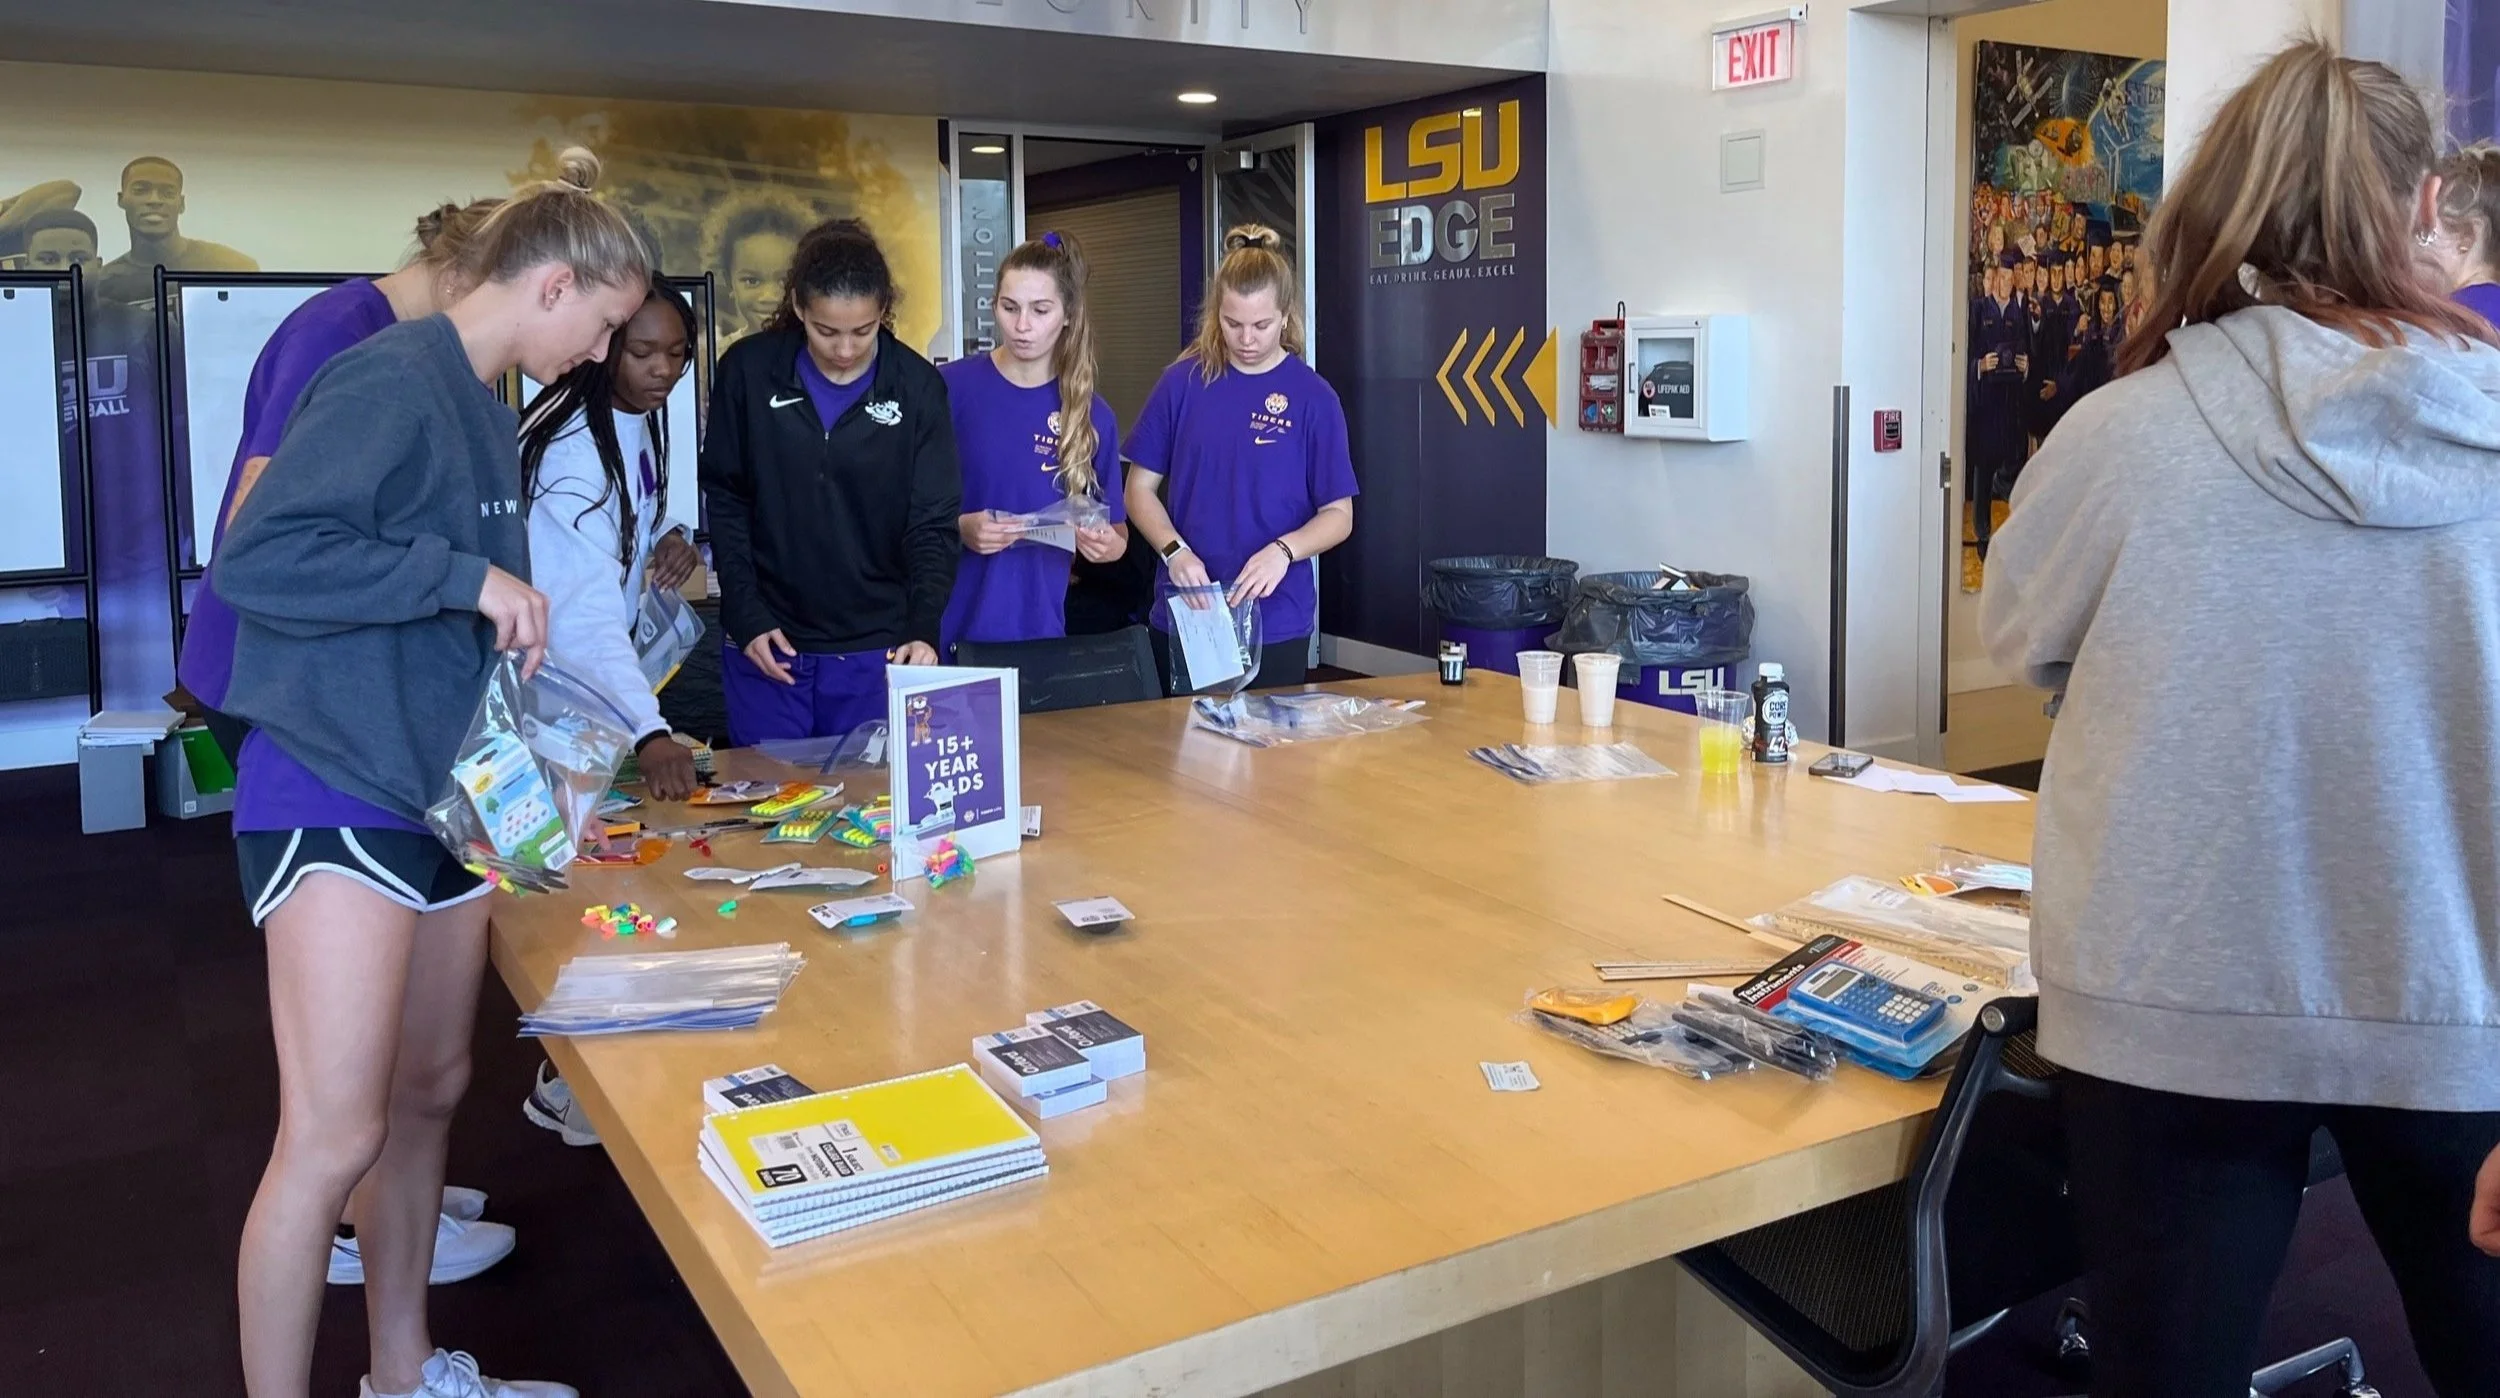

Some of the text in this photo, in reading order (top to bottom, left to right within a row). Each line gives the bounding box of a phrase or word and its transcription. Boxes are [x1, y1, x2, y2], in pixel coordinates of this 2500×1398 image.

[1728, 28, 1780, 83] EXIT
[1364, 99, 1520, 204] LSU
[1369, 193, 1516, 269] EDGE
[480, 499, 518, 518] NEW
[1658, 667, 1725, 697] LSU
[936, 735, 974, 757] 15+
[925, 752, 979, 780] YEAR
[1738, 980, 1769, 1000] Texas
[1749, 963, 1805, 1003] Instruments
[1056, 1025, 1094, 1047] Oxford
[1002, 1051, 1039, 1074] Oxford
[772, 1167, 802, 1182] 70
